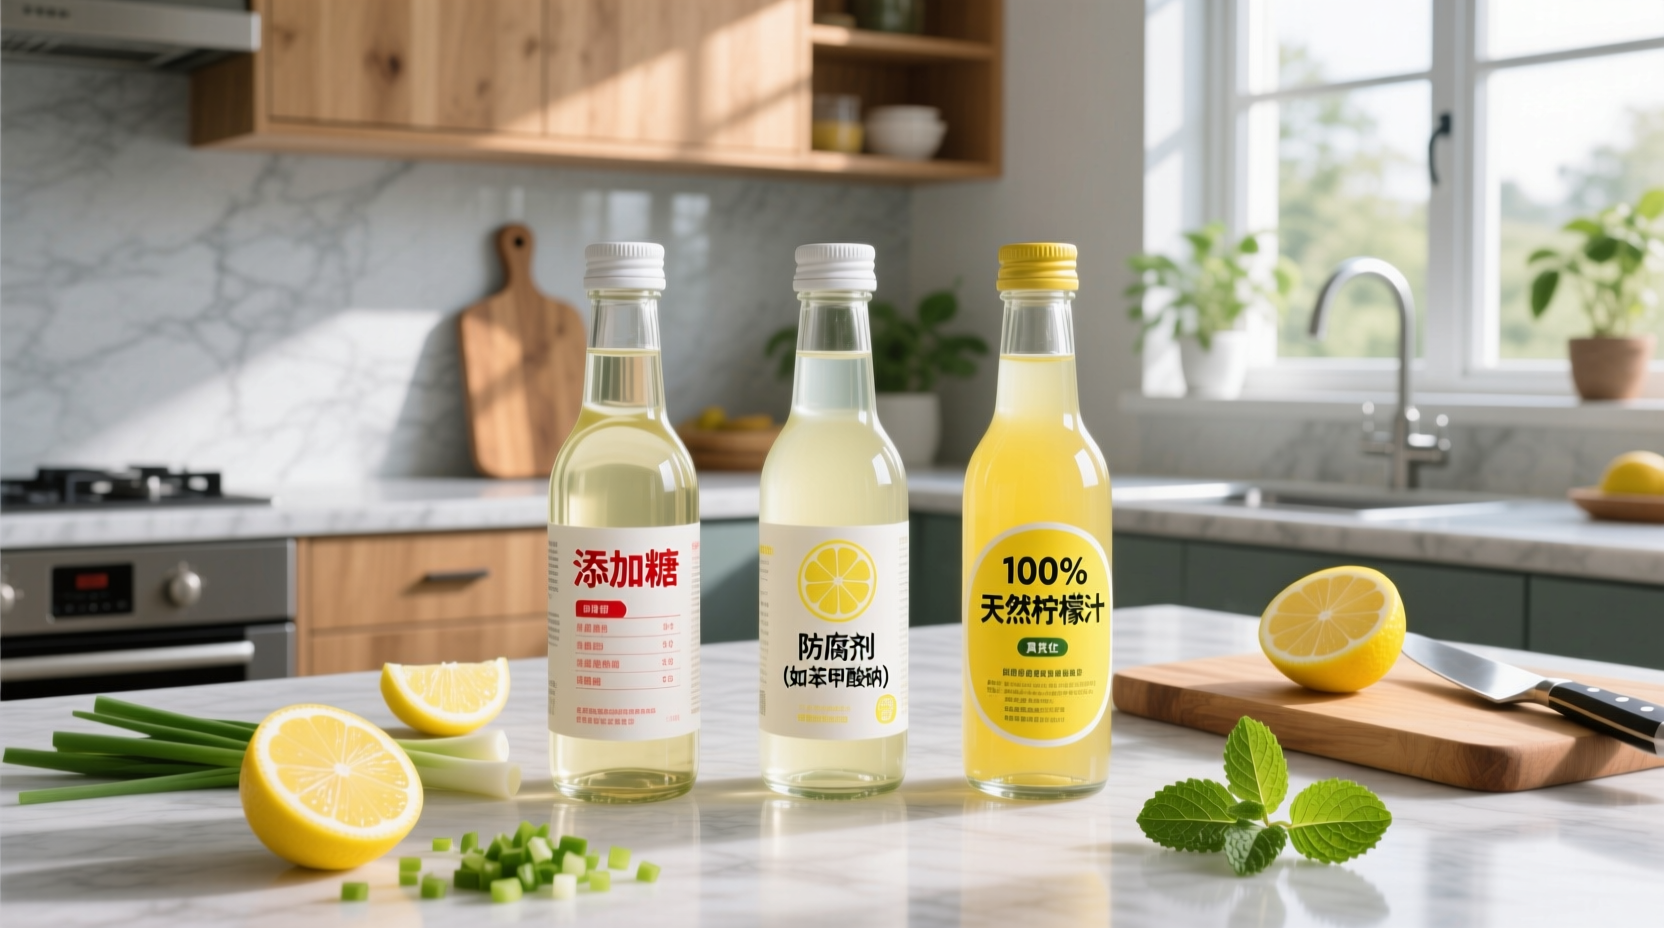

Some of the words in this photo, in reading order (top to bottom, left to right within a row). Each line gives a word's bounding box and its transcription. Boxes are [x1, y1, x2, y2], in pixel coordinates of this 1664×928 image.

[572, 548, 679, 589] 添加糖
[1002, 556, 1088, 586] 100%
[980, 592, 1105, 626] 天然柠檬汁
[798, 631, 875, 661] 防腐剂
